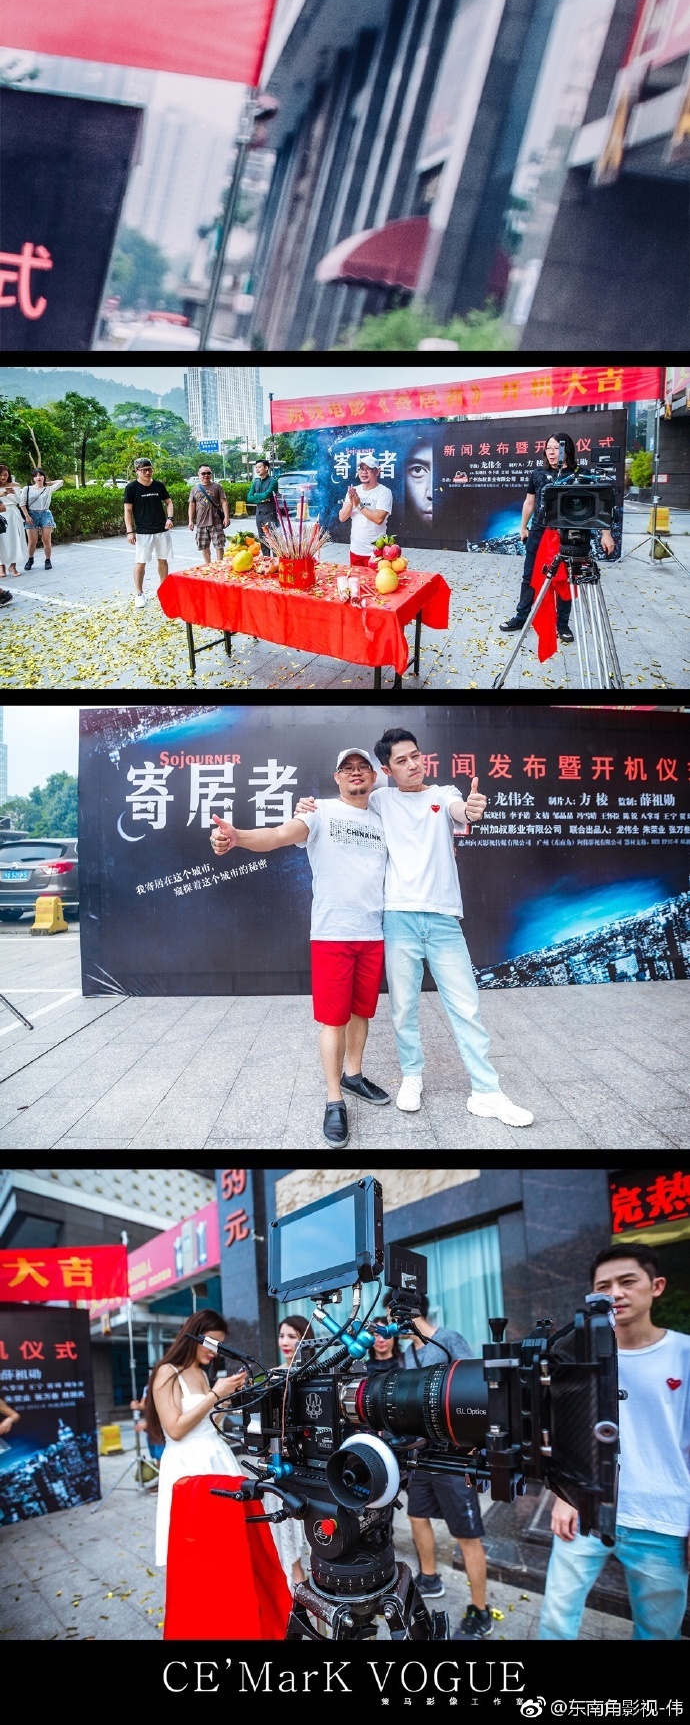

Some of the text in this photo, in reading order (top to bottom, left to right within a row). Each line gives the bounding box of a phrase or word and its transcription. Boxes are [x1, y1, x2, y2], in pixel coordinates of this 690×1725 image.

[420, 753, 690, 782] 新闻发布暨开机仪
[126, 759, 298, 830] 寄居者
[2, 1256, 94, 1289] 大吉
